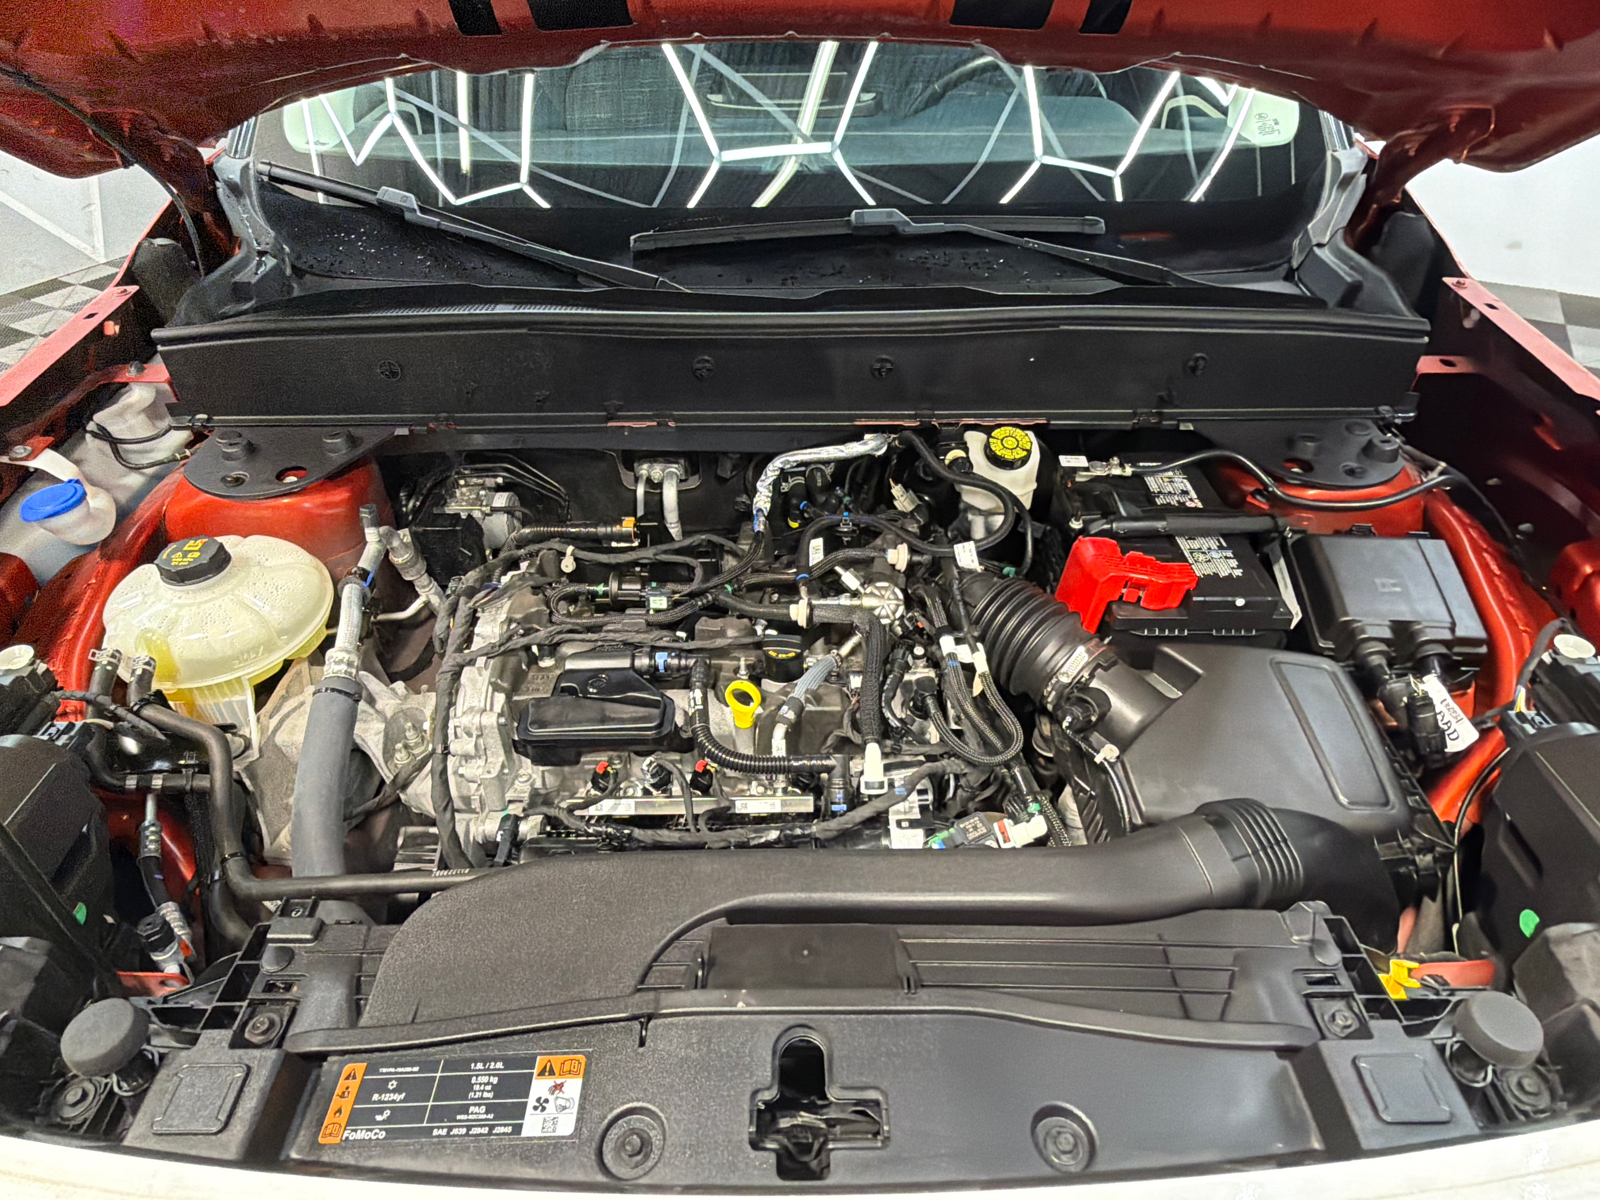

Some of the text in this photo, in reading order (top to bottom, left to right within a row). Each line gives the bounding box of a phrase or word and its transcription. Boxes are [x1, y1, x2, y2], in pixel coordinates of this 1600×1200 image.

[489, 1076, 499, 1085] kg
[372, 1092, 406, 1102] R-1234yf
[468, 1105, 487, 1114] PAG
[342, 1129, 386, 1141] FoMoCo
[432, 1126, 448, 1136] SAE
[469, 1126, 489, 1136] J2842
